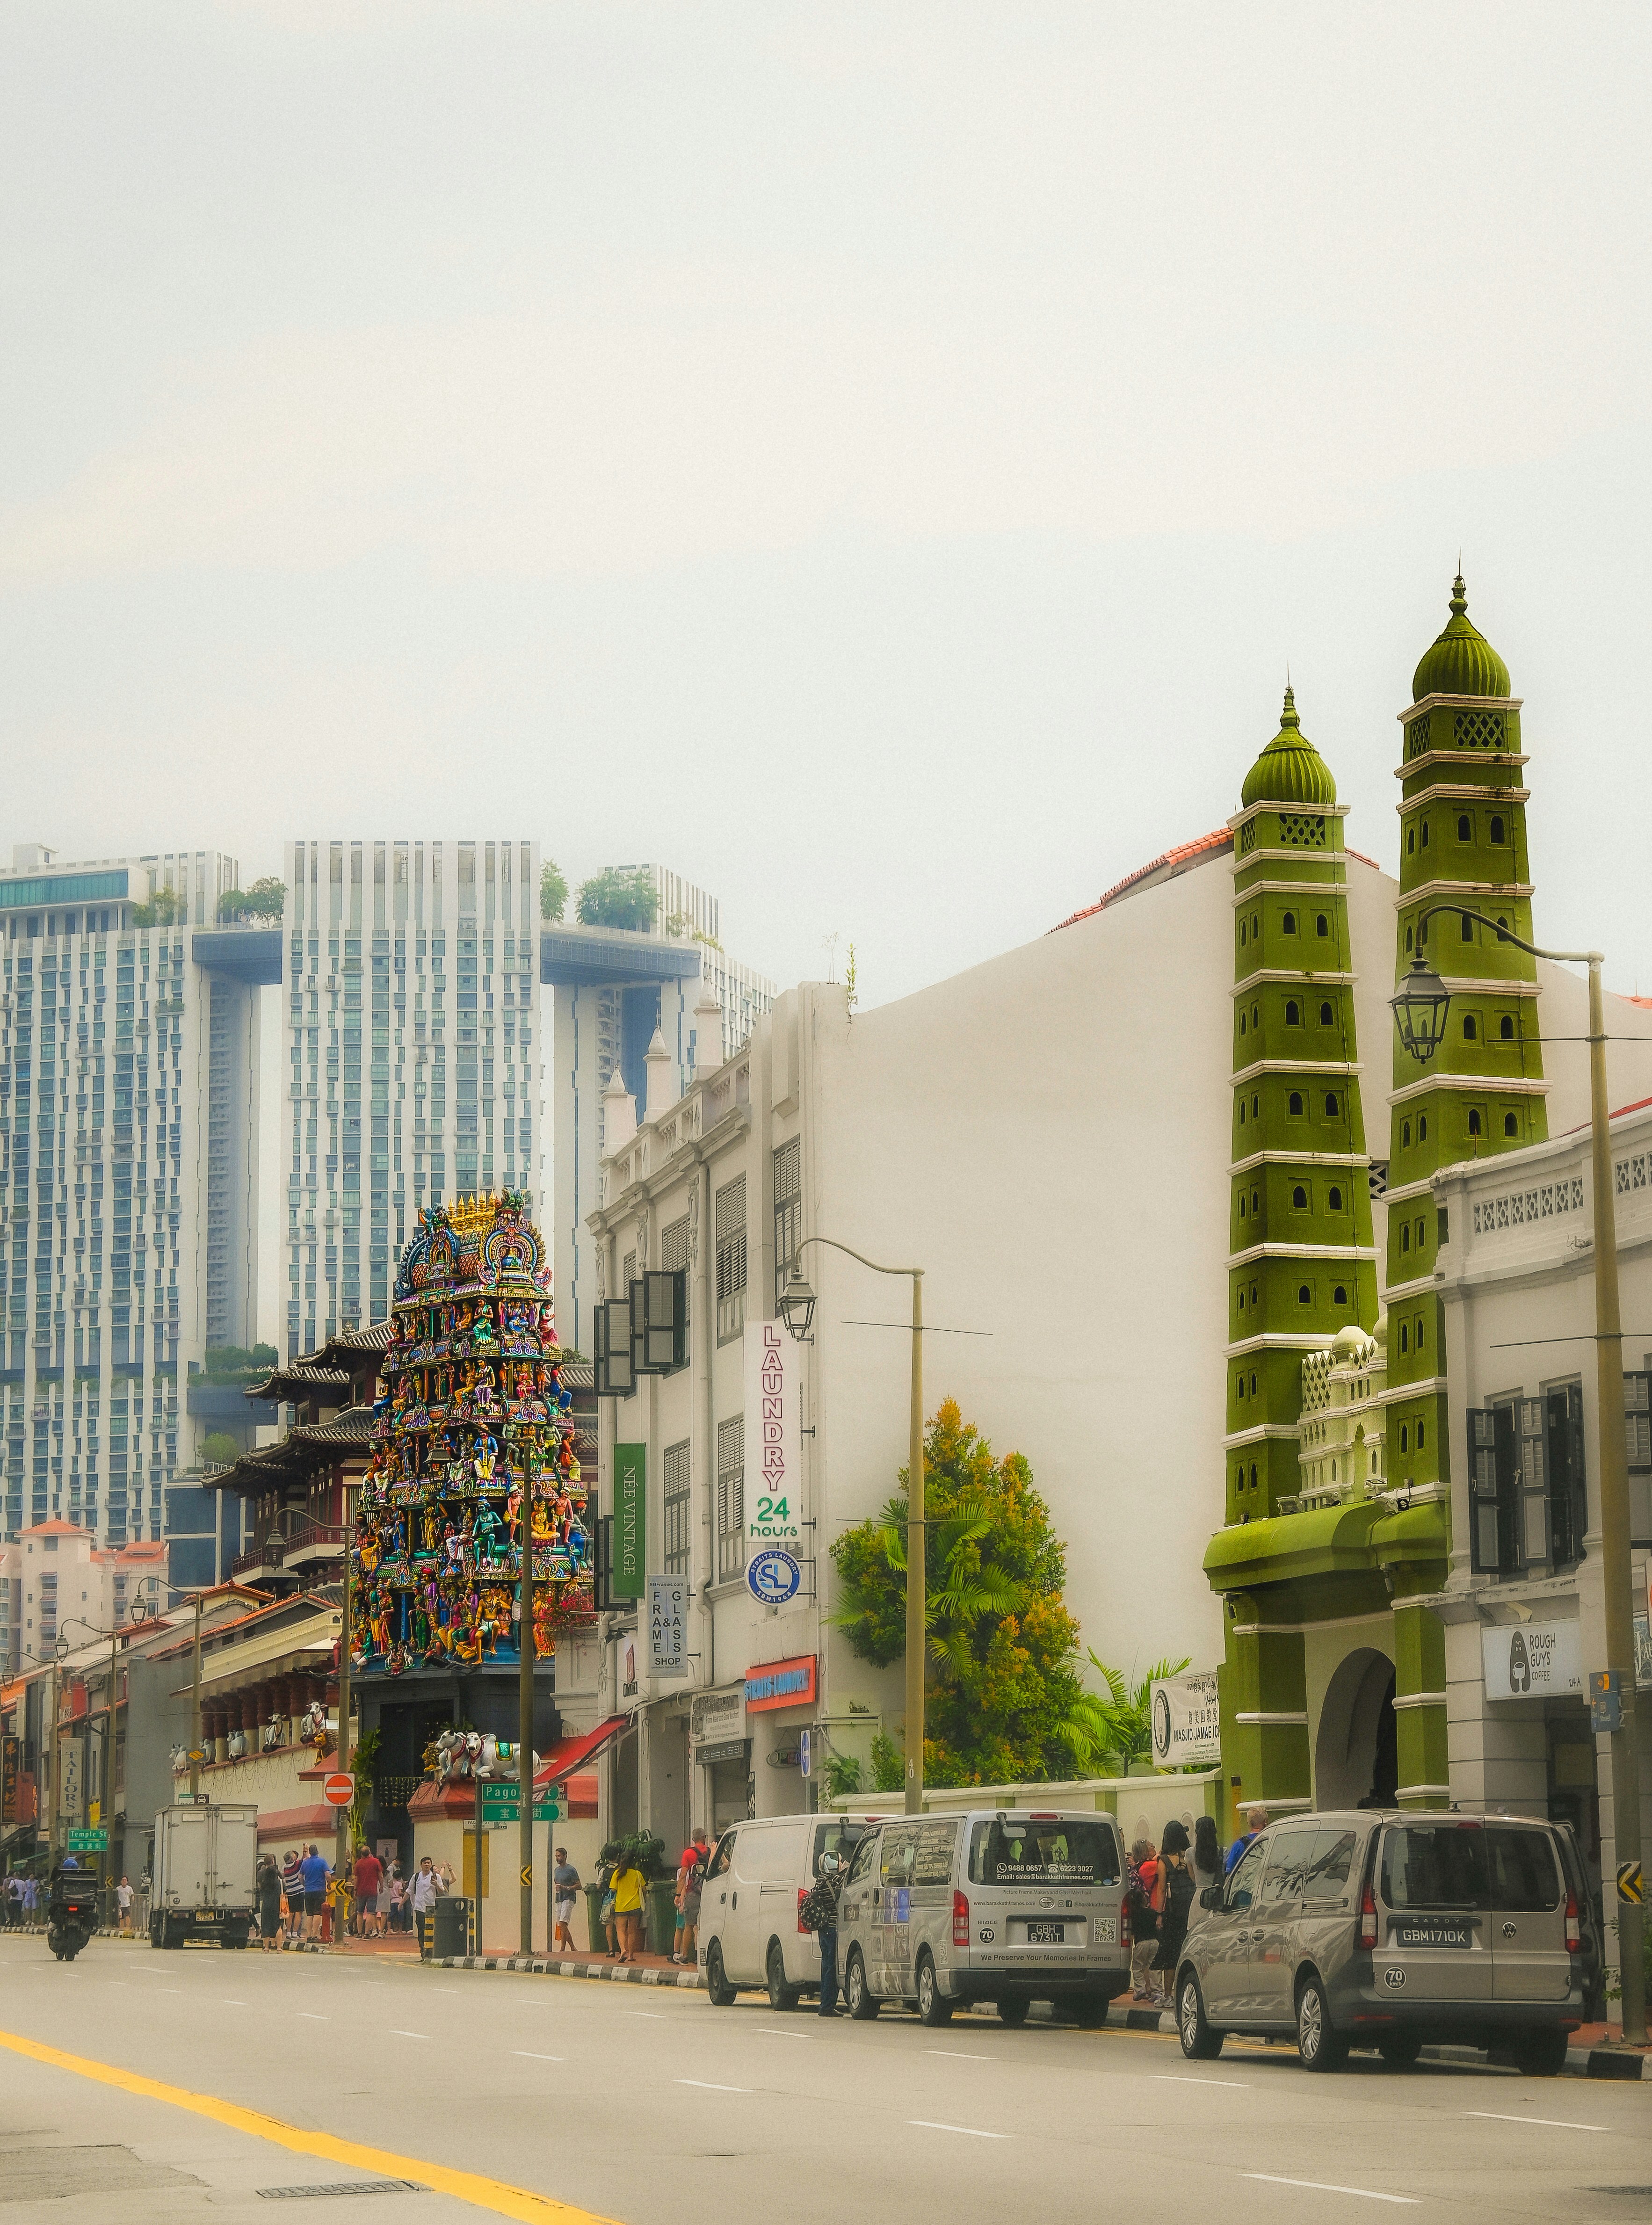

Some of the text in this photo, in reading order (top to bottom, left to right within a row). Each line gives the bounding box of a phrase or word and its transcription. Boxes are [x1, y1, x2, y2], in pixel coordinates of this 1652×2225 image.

[761, 1326, 785, 1491] LAUNDRY
[757, 1497, 790, 1522] 24
[623, 1466, 639, 1576] NÉE VINTAGE
[750, 1524, 798, 1537] hours
[751, 1552, 798, 1575] STRAITS LAUNDRY
[652, 1591, 662, 1653] FRAME
[663, 1618, 671, 1627] &
[672, 1591, 681, 1652] GLASS
[1529, 1632, 1556, 1652] ROUGH
[1530, 1651, 1551, 1668] GUYS
[1532, 1670, 1550, 1681] COFFEE
[744, 1668, 806, 1702] STRAITS LAUNDRY
[1174, 1728, 1193, 1742] MASJID
[1194, 1726, 1211, 1741] JAMAE
[909, 1758, 914, 1778] 40
[65, 1751, 78, 1810] TAILORS
[522, 1792, 526, 1808] 38
[1030, 1933, 1061, 1942] 6731T
[1036, 1924, 1055, 1933] GBH
[1403, 1929, 1466, 1942] GBM1710K
[1388, 1971, 1403, 1981] 70
